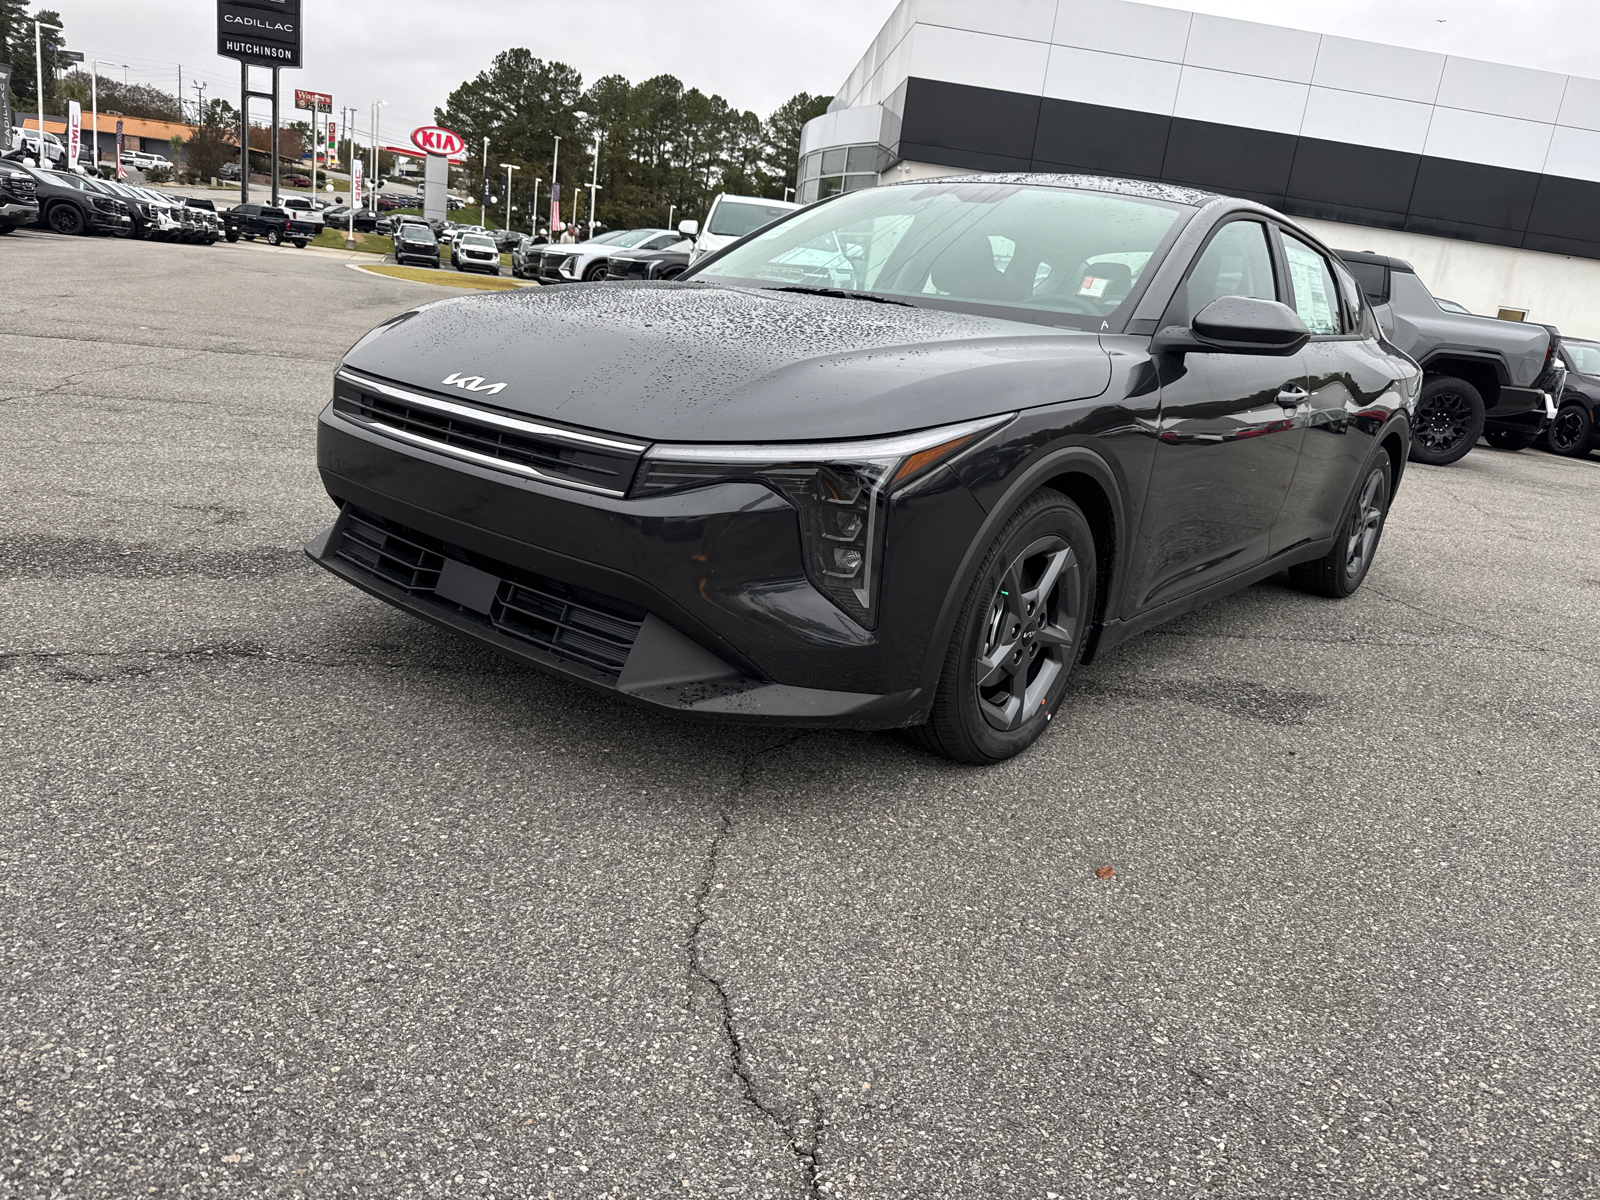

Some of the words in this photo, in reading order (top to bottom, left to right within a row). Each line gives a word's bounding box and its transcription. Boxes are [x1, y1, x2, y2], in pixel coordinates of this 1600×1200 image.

[224, 14, 294, 32] CADILLAC
[226, 40, 291, 59] HUTCHINSON
[297, 90, 331, 103] Wagrs
[71, 114, 79, 158] GMC
[422, 130, 456, 152] KIA
[1100, 320, 1109, 331] A
[441, 372, 508, 396] KIA
